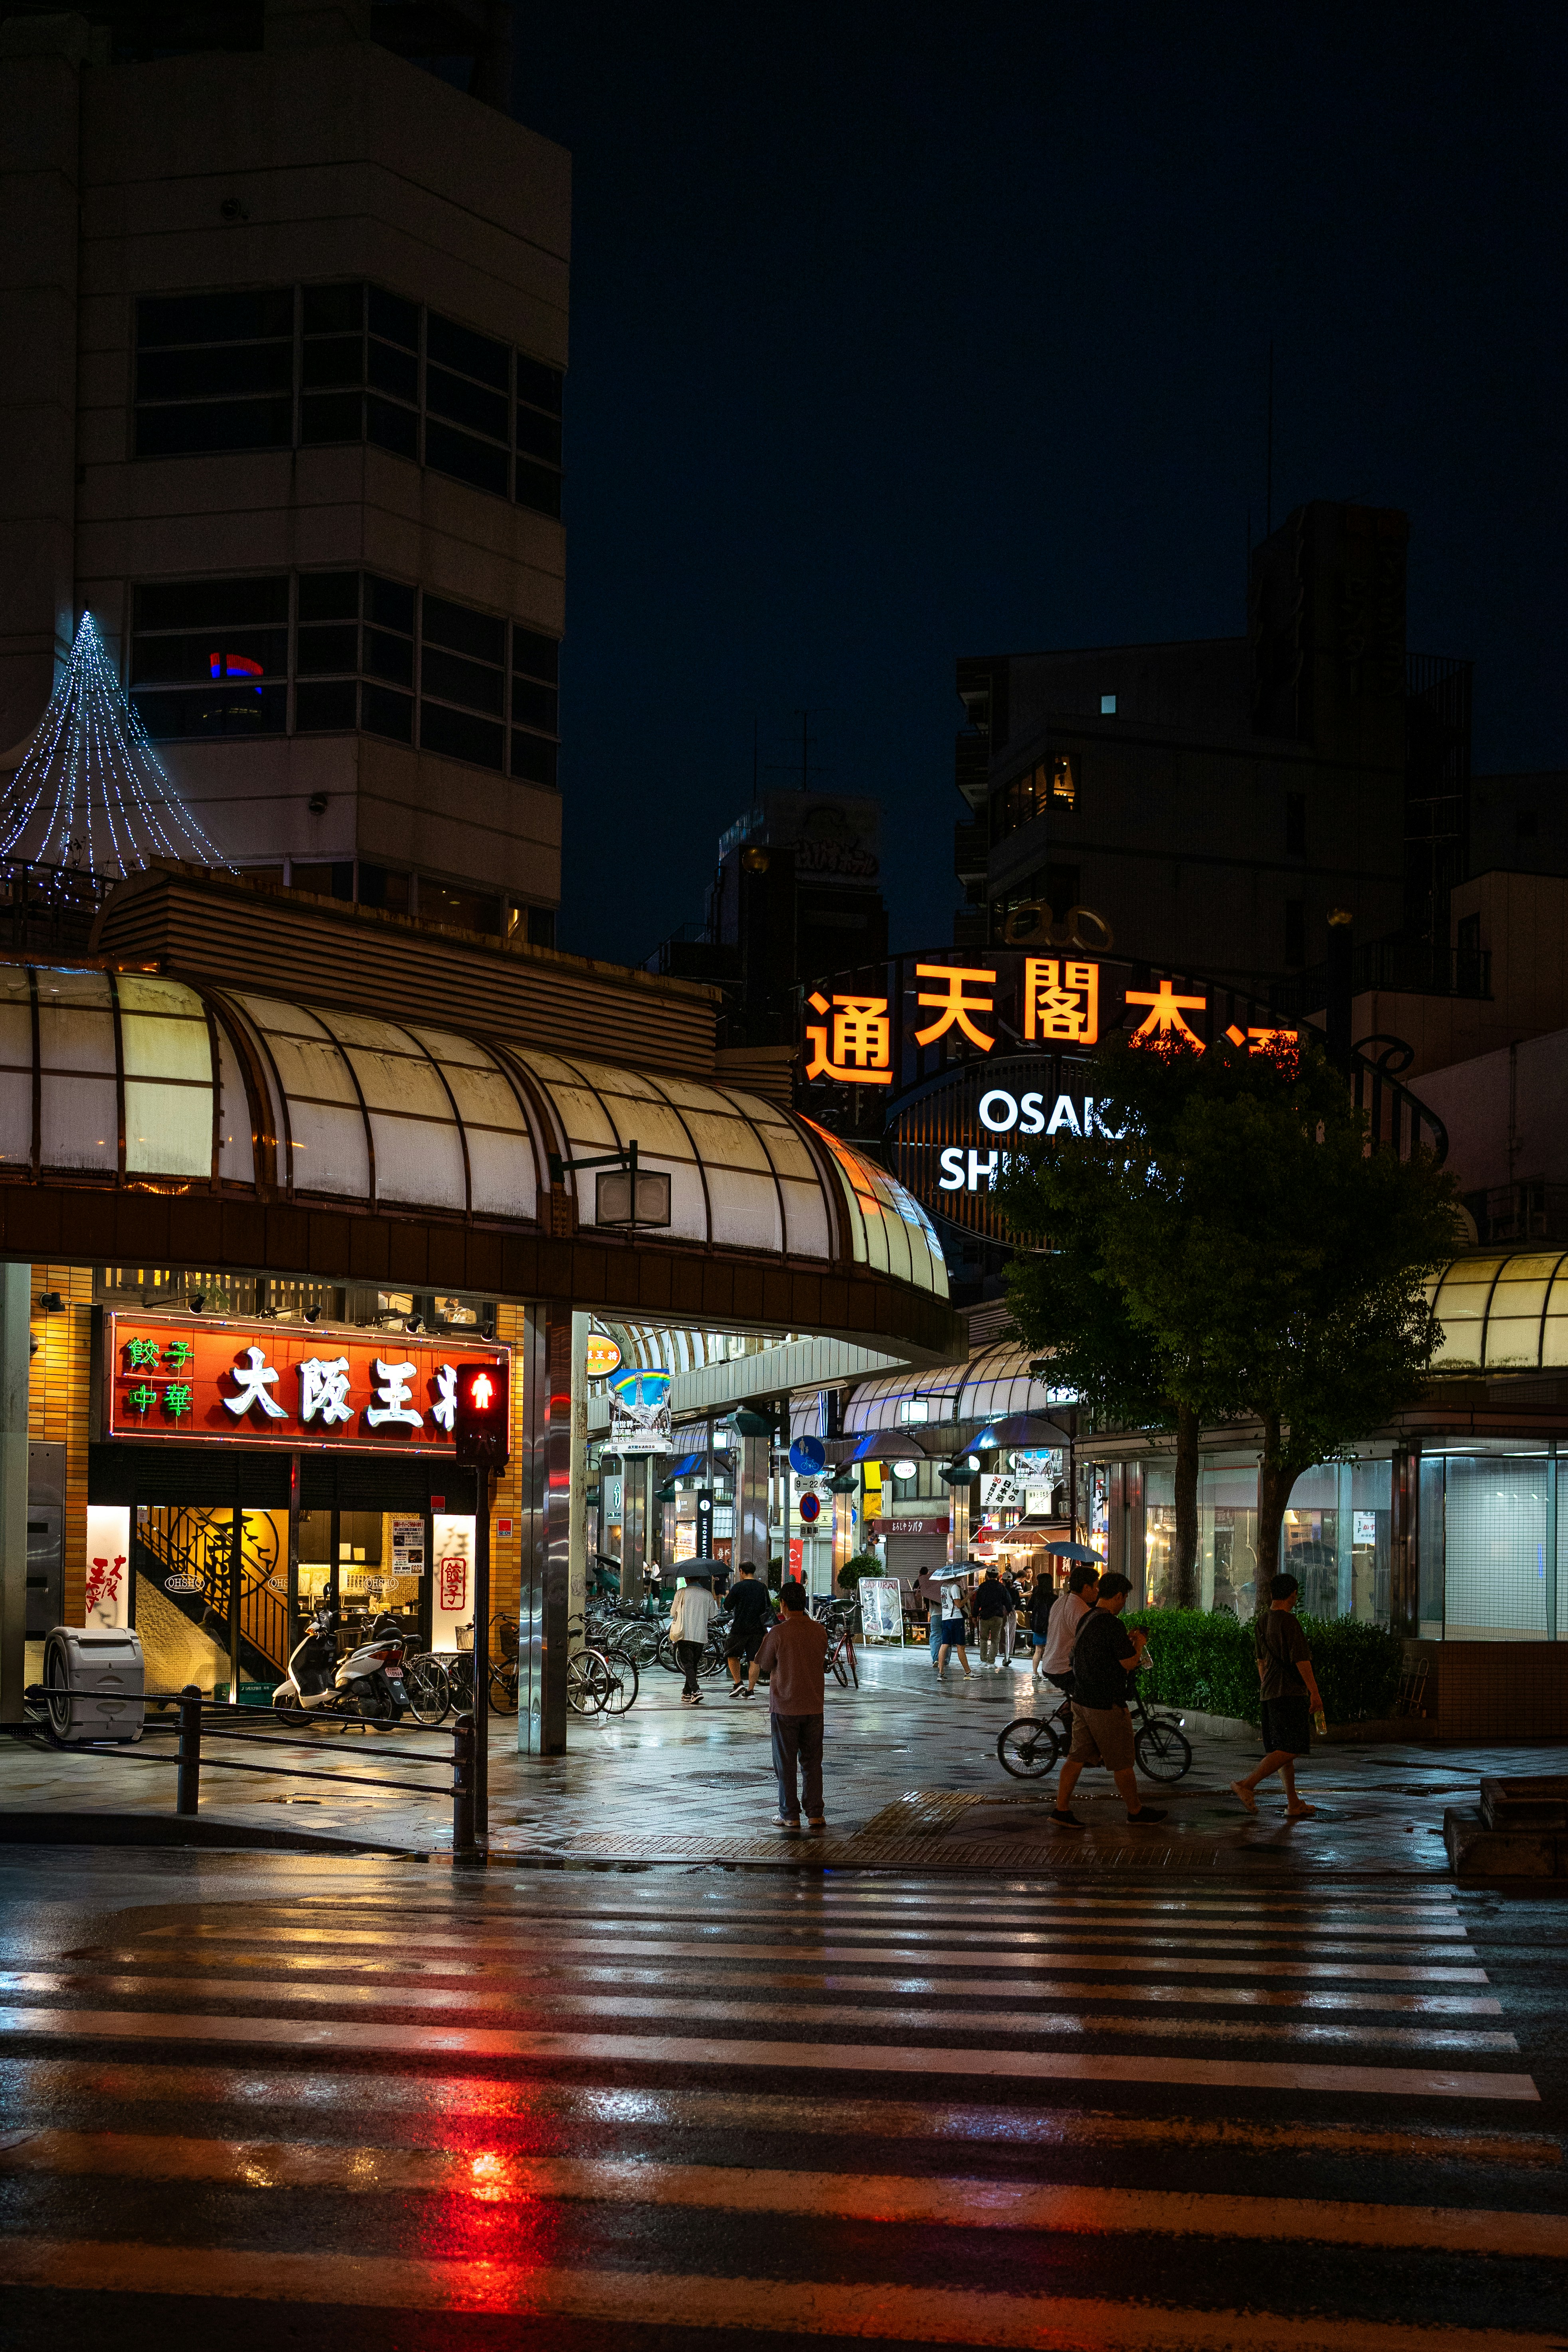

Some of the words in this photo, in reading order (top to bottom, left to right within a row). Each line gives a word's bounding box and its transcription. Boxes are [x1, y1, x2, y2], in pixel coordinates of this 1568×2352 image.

[126, 1337, 194, 1368] 餃子
[128, 1384, 194, 1417] 中華
[995, 1480, 1012, 1503] 日本酒
[908, 1521, 923, 1532] シバタ
[168, 1578, 201, 1587] OHSHO
[445, 1563, 461, 1604] 餃子
